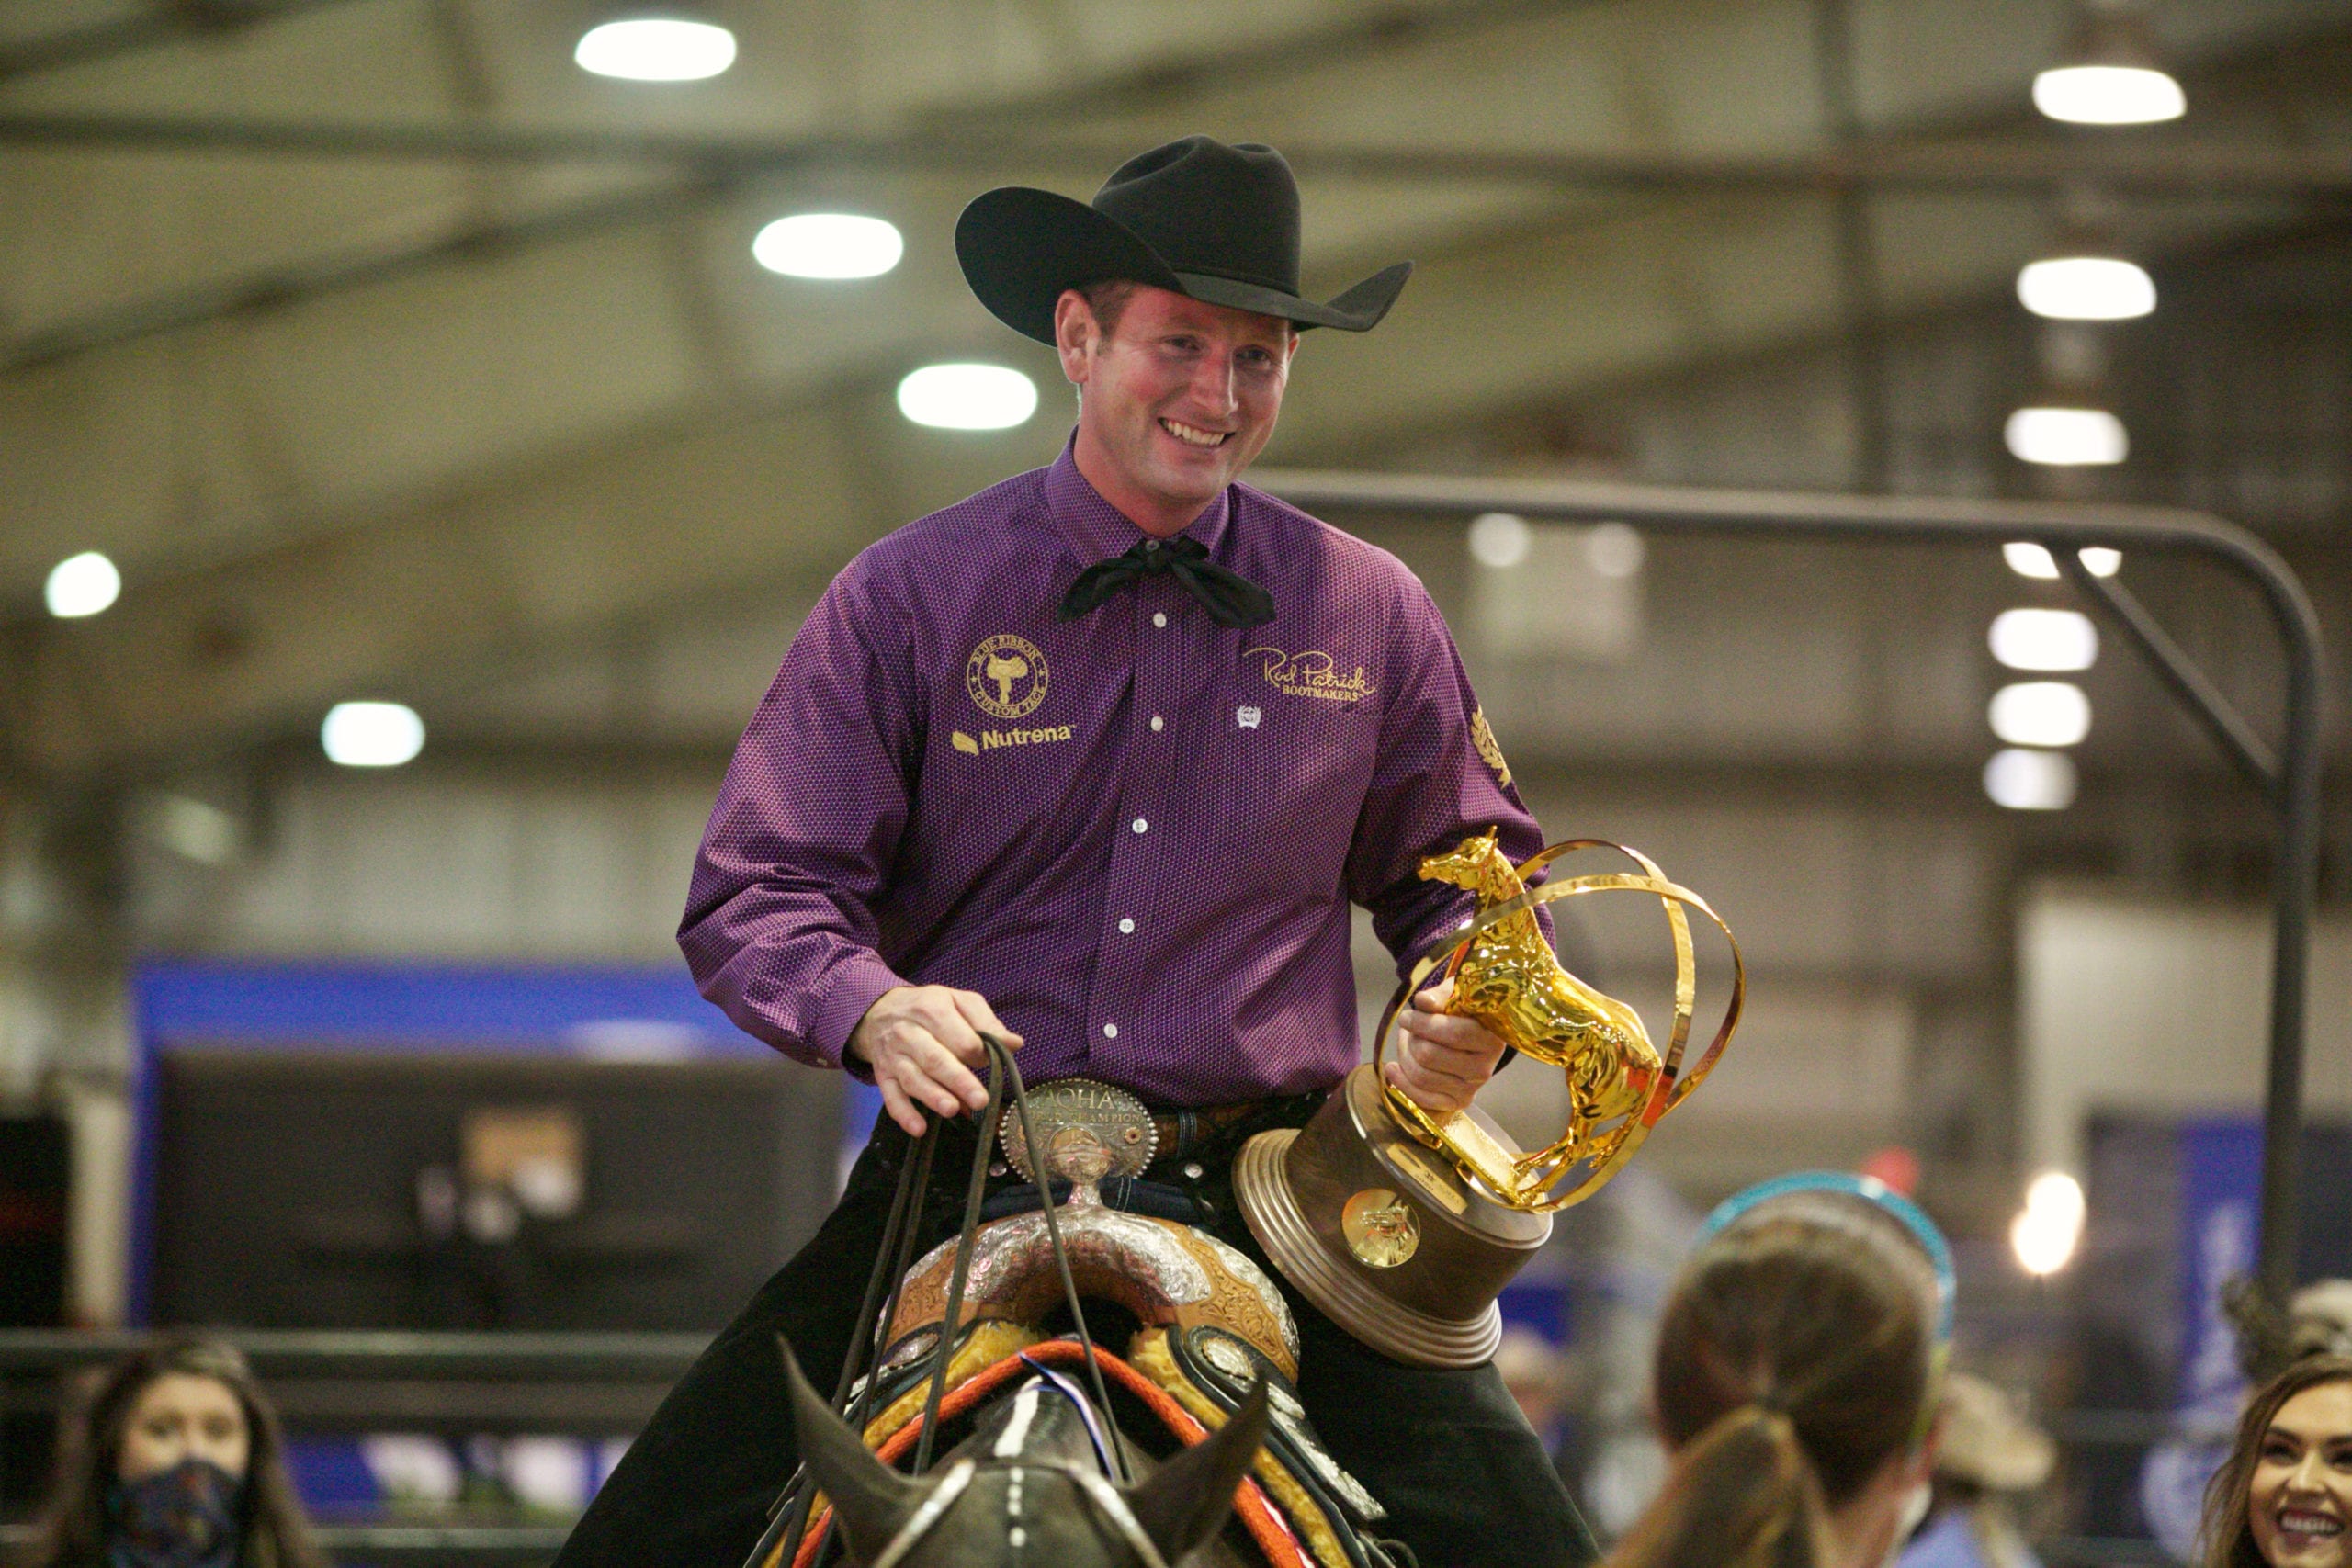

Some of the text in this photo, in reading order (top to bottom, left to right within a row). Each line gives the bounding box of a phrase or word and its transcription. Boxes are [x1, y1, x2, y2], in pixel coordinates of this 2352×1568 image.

[972, 636, 1040, 664] BLUE RIBBON
[1243, 647, 1376, 694] Rod Patrick
[975, 691, 1022, 716] CUSTOM
[1283, 685, 1359, 702] BOOTMAKERS
[982, 725, 1071, 750] Nutrena
[1042, 1088, 1115, 1111] AQHA
